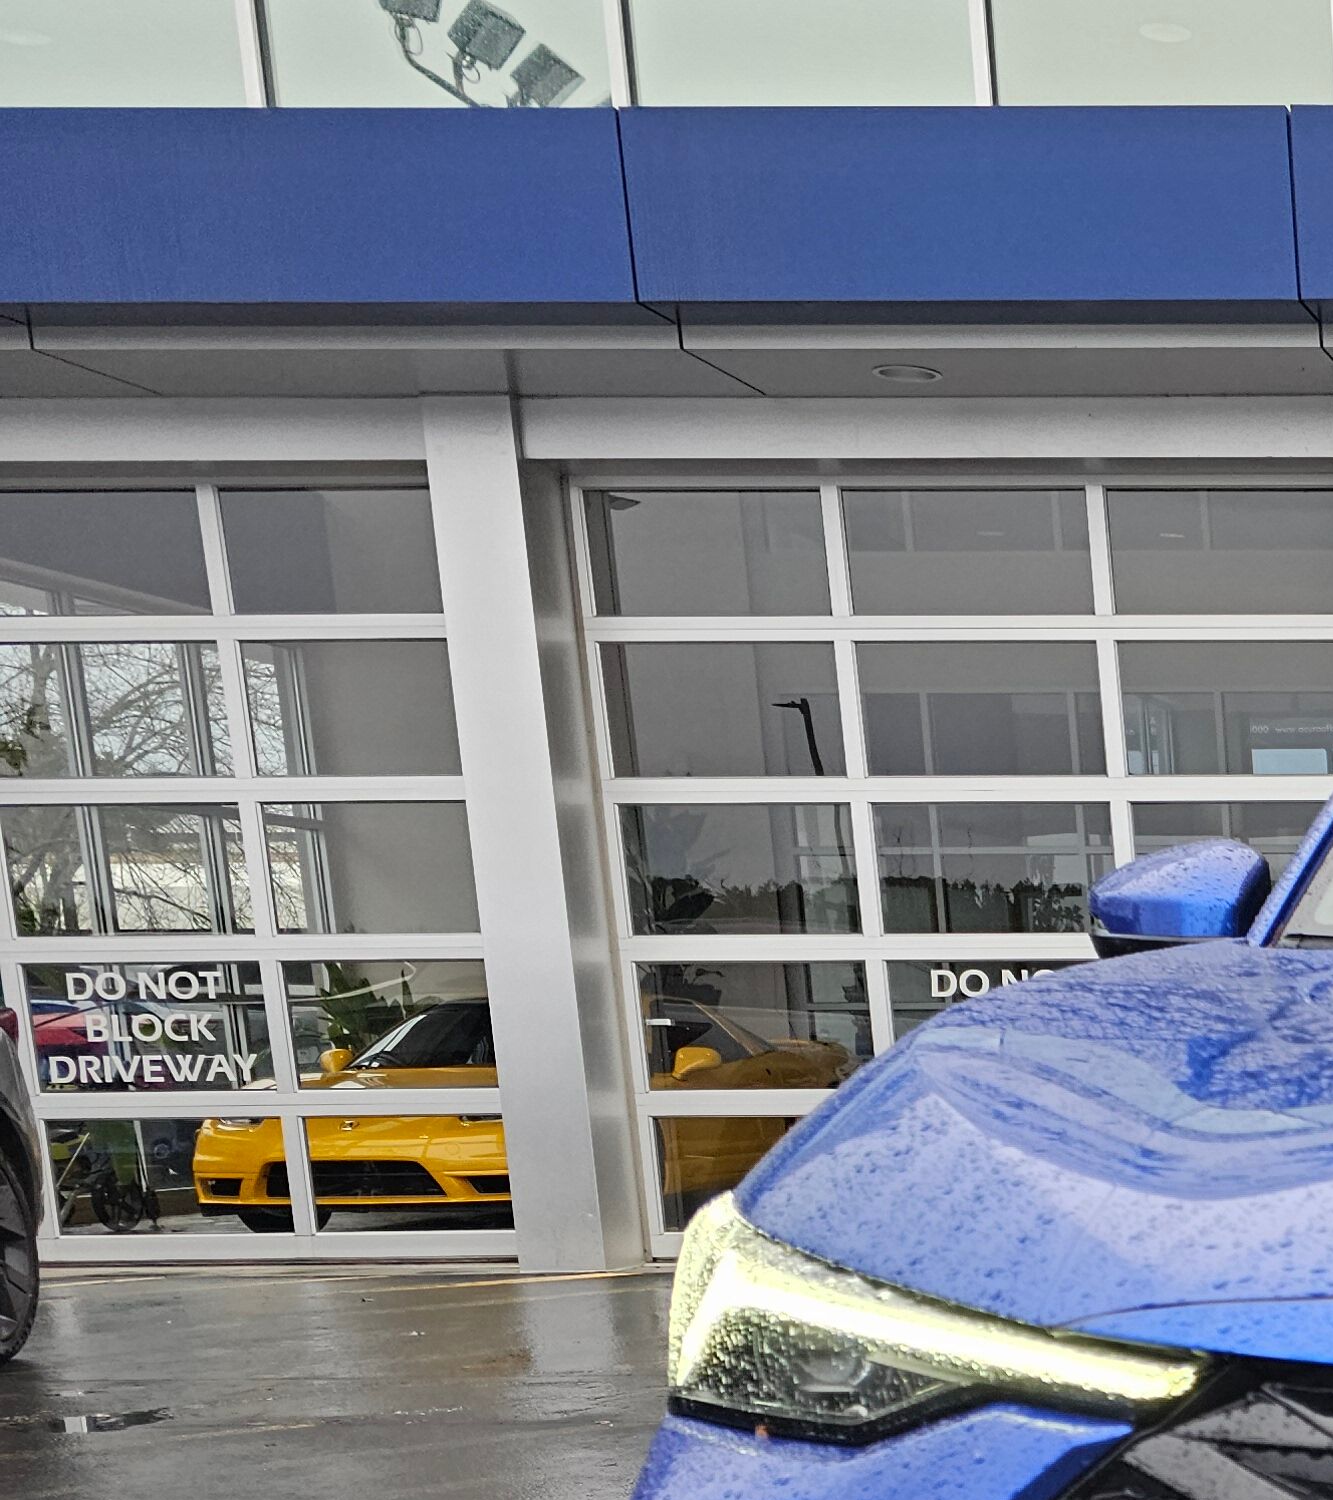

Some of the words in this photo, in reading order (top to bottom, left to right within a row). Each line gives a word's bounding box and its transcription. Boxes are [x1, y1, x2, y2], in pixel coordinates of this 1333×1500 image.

[65, 971, 127, 1001] DO
[137, 970, 222, 1000] NOT
[930, 968, 990, 998] DO
[85, 1013, 217, 1043] BLOCK
[48, 1053, 258, 1084] DRIVEWAY
